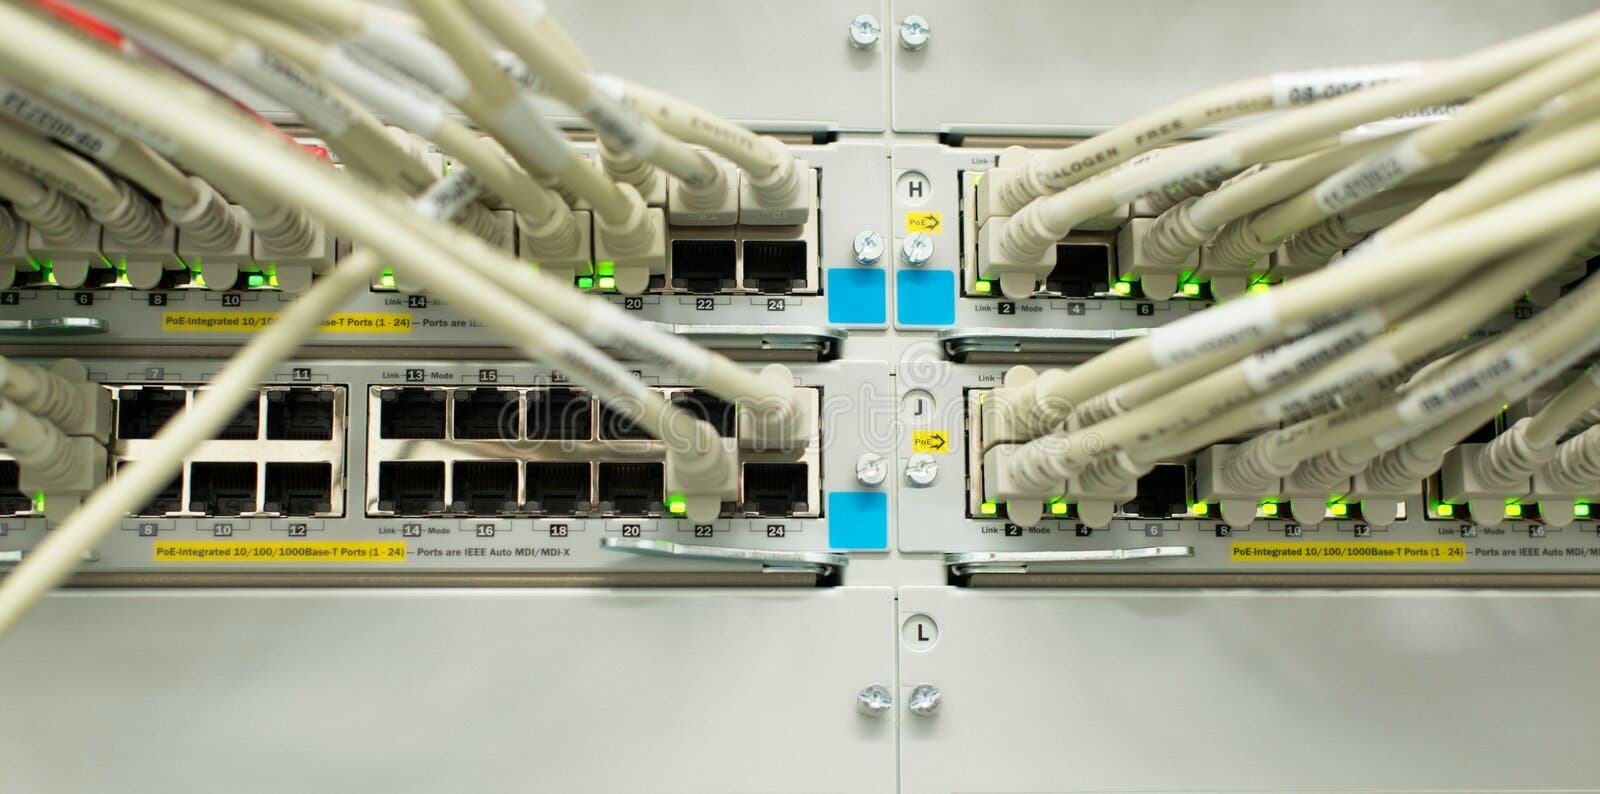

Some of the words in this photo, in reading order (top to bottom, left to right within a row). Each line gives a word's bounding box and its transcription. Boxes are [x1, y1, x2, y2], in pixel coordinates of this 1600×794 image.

[1135, 119, 1182, 145] FREE
[972, 157, 988, 165] Link
[908, 181, 923, 198] H
[909, 219, 927, 227] PoE
[5, 294, 14, 303] 4
[79, 294, 88, 304] 6
[153, 294, 162, 305] 8
[224, 295, 240, 306] 10
[410, 297, 425, 307] 14
[626, 299, 642, 309] 20
[697, 300, 713, 310] 22
[768, 301, 784, 310] 24
[975, 304, 992, 312] Link
[1003, 303, 1010, 313] 2
[1021, 304, 1043, 312] Mode
[1072, 304, 1081, 313] 4
[1141, 304, 1149, 314] 6
[166, 316, 239, 326] PoE-Integrated
[347, 318, 373, 327] Ports
[394, 318, 410, 328] 24)
[423, 319, 448, 327] Ports
[295, 370, 310, 379] 11
[408, 370, 423, 380] 13
[480, 371, 496, 381] 15
[914, 399, 923, 416] J
[915, 438, 932, 446] PoE
[144, 525, 152, 535] 8
[216, 526, 231, 536] 10
[291, 526, 306, 536] 12
[404, 526, 420, 536] 14
[478, 526, 494, 536] 16
[551, 526, 567, 536] 18
[624, 526, 640, 536] 20
[697, 526, 712, 536] 22
[769, 526, 784, 536] 24
[981, 526, 998, 534] Link
[1009, 525, 1017, 535] 2
[1150, 525, 1158, 535] 6
[1220, 526, 1228, 536] 8
[1286, 526, 1301, 536] 10
[1356, 526, 1370, 536] 12
[1462, 526, 1477, 536] 14
[1530, 526, 1545, 537] 16
[156, 547, 230, 557] PoE-Integrated
[233, 547, 337, 557] 10/100/1000Base-T
[388, 548, 405, 558] 24)
[515, 548, 570, 557] MDI/MDI-X
[1233, 547, 1302, 557] PoE-Integrated
[1305, 547, 1401, 557] 10/100/1000Base-T
[1448, 548, 1464, 558] 24)
[918, 624, 929, 641] L
